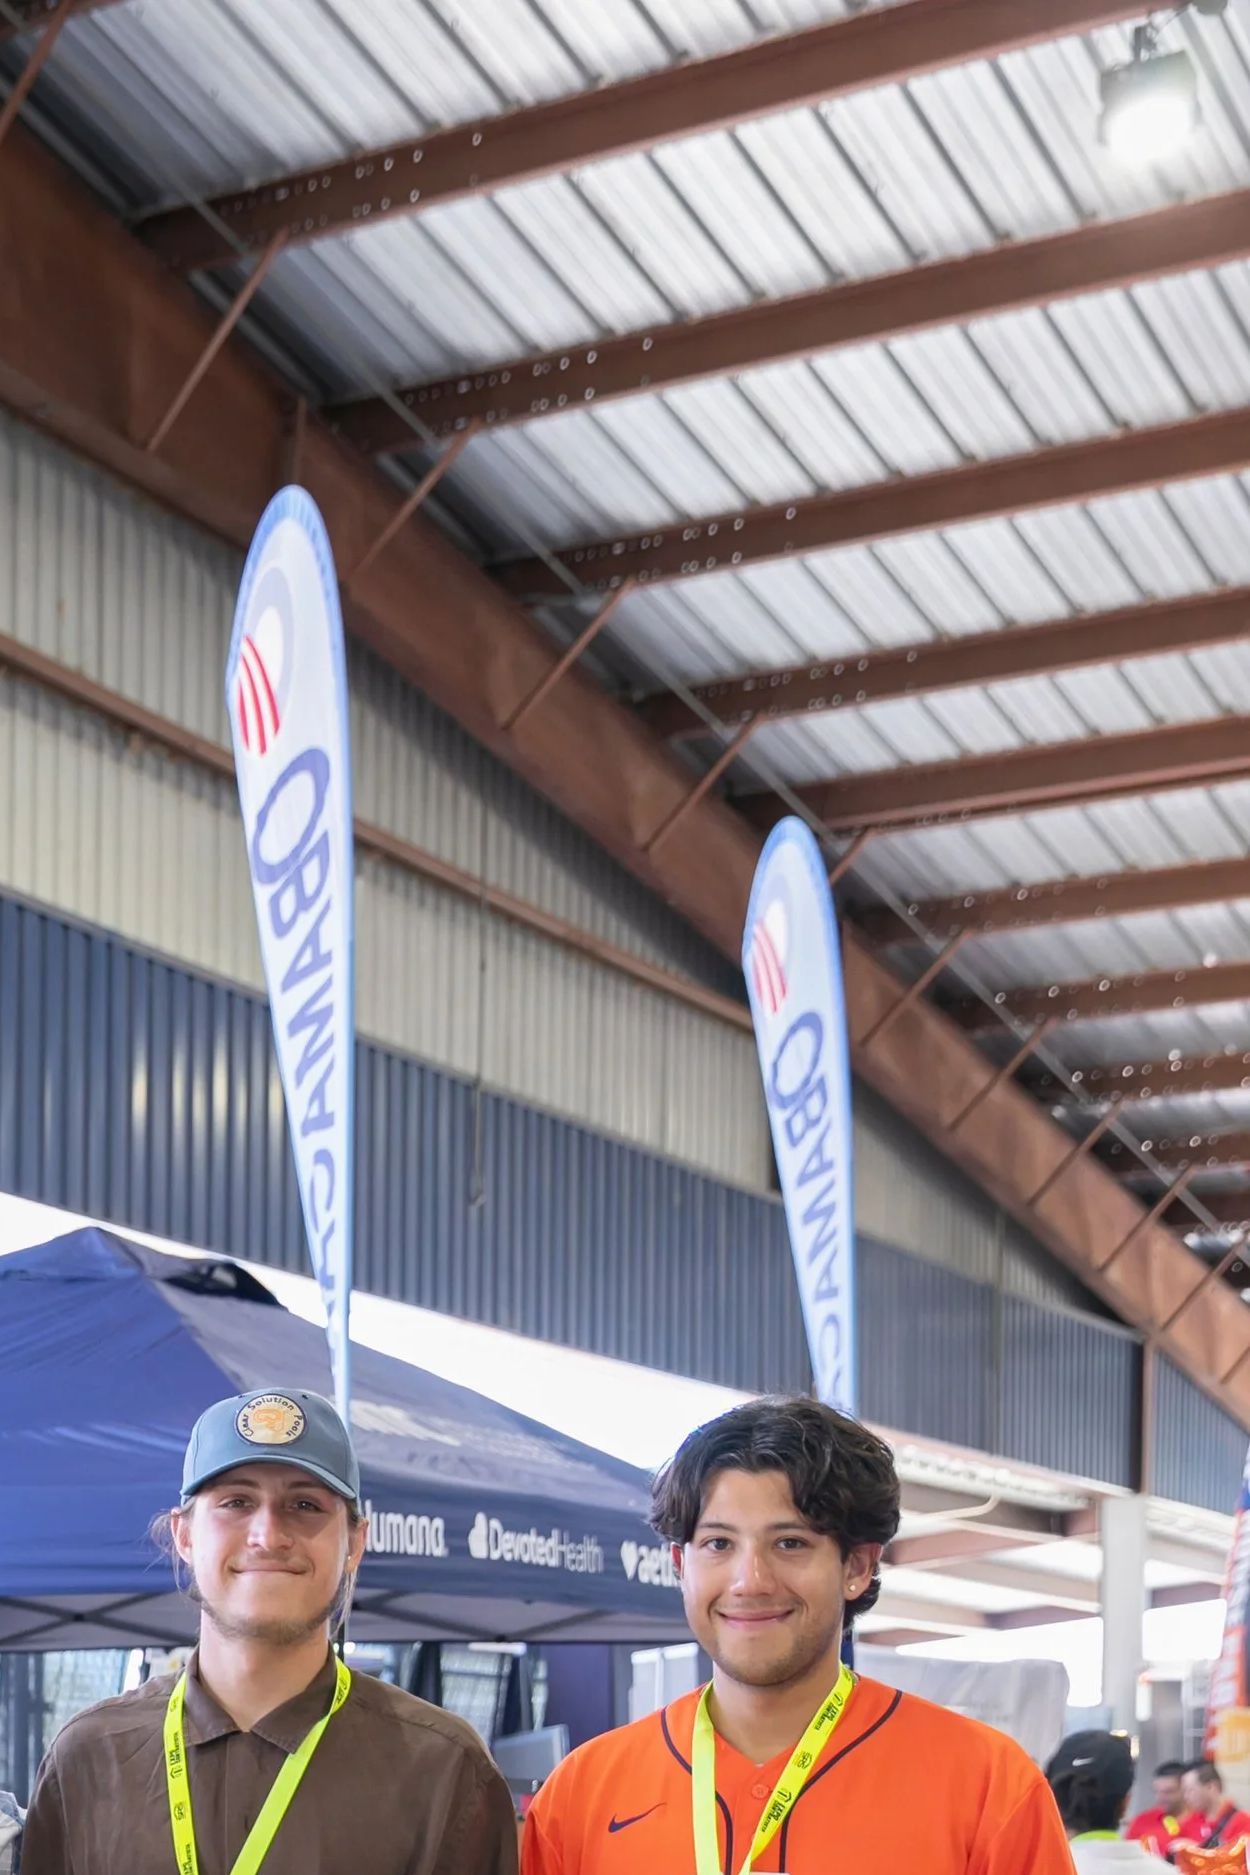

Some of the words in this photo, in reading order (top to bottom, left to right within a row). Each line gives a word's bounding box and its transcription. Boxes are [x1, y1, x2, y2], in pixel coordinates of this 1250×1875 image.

[247, 1396, 295, 1411] Solution
[242, 1414, 255, 1437] Clear
[285, 1414, 303, 1437] Pools
